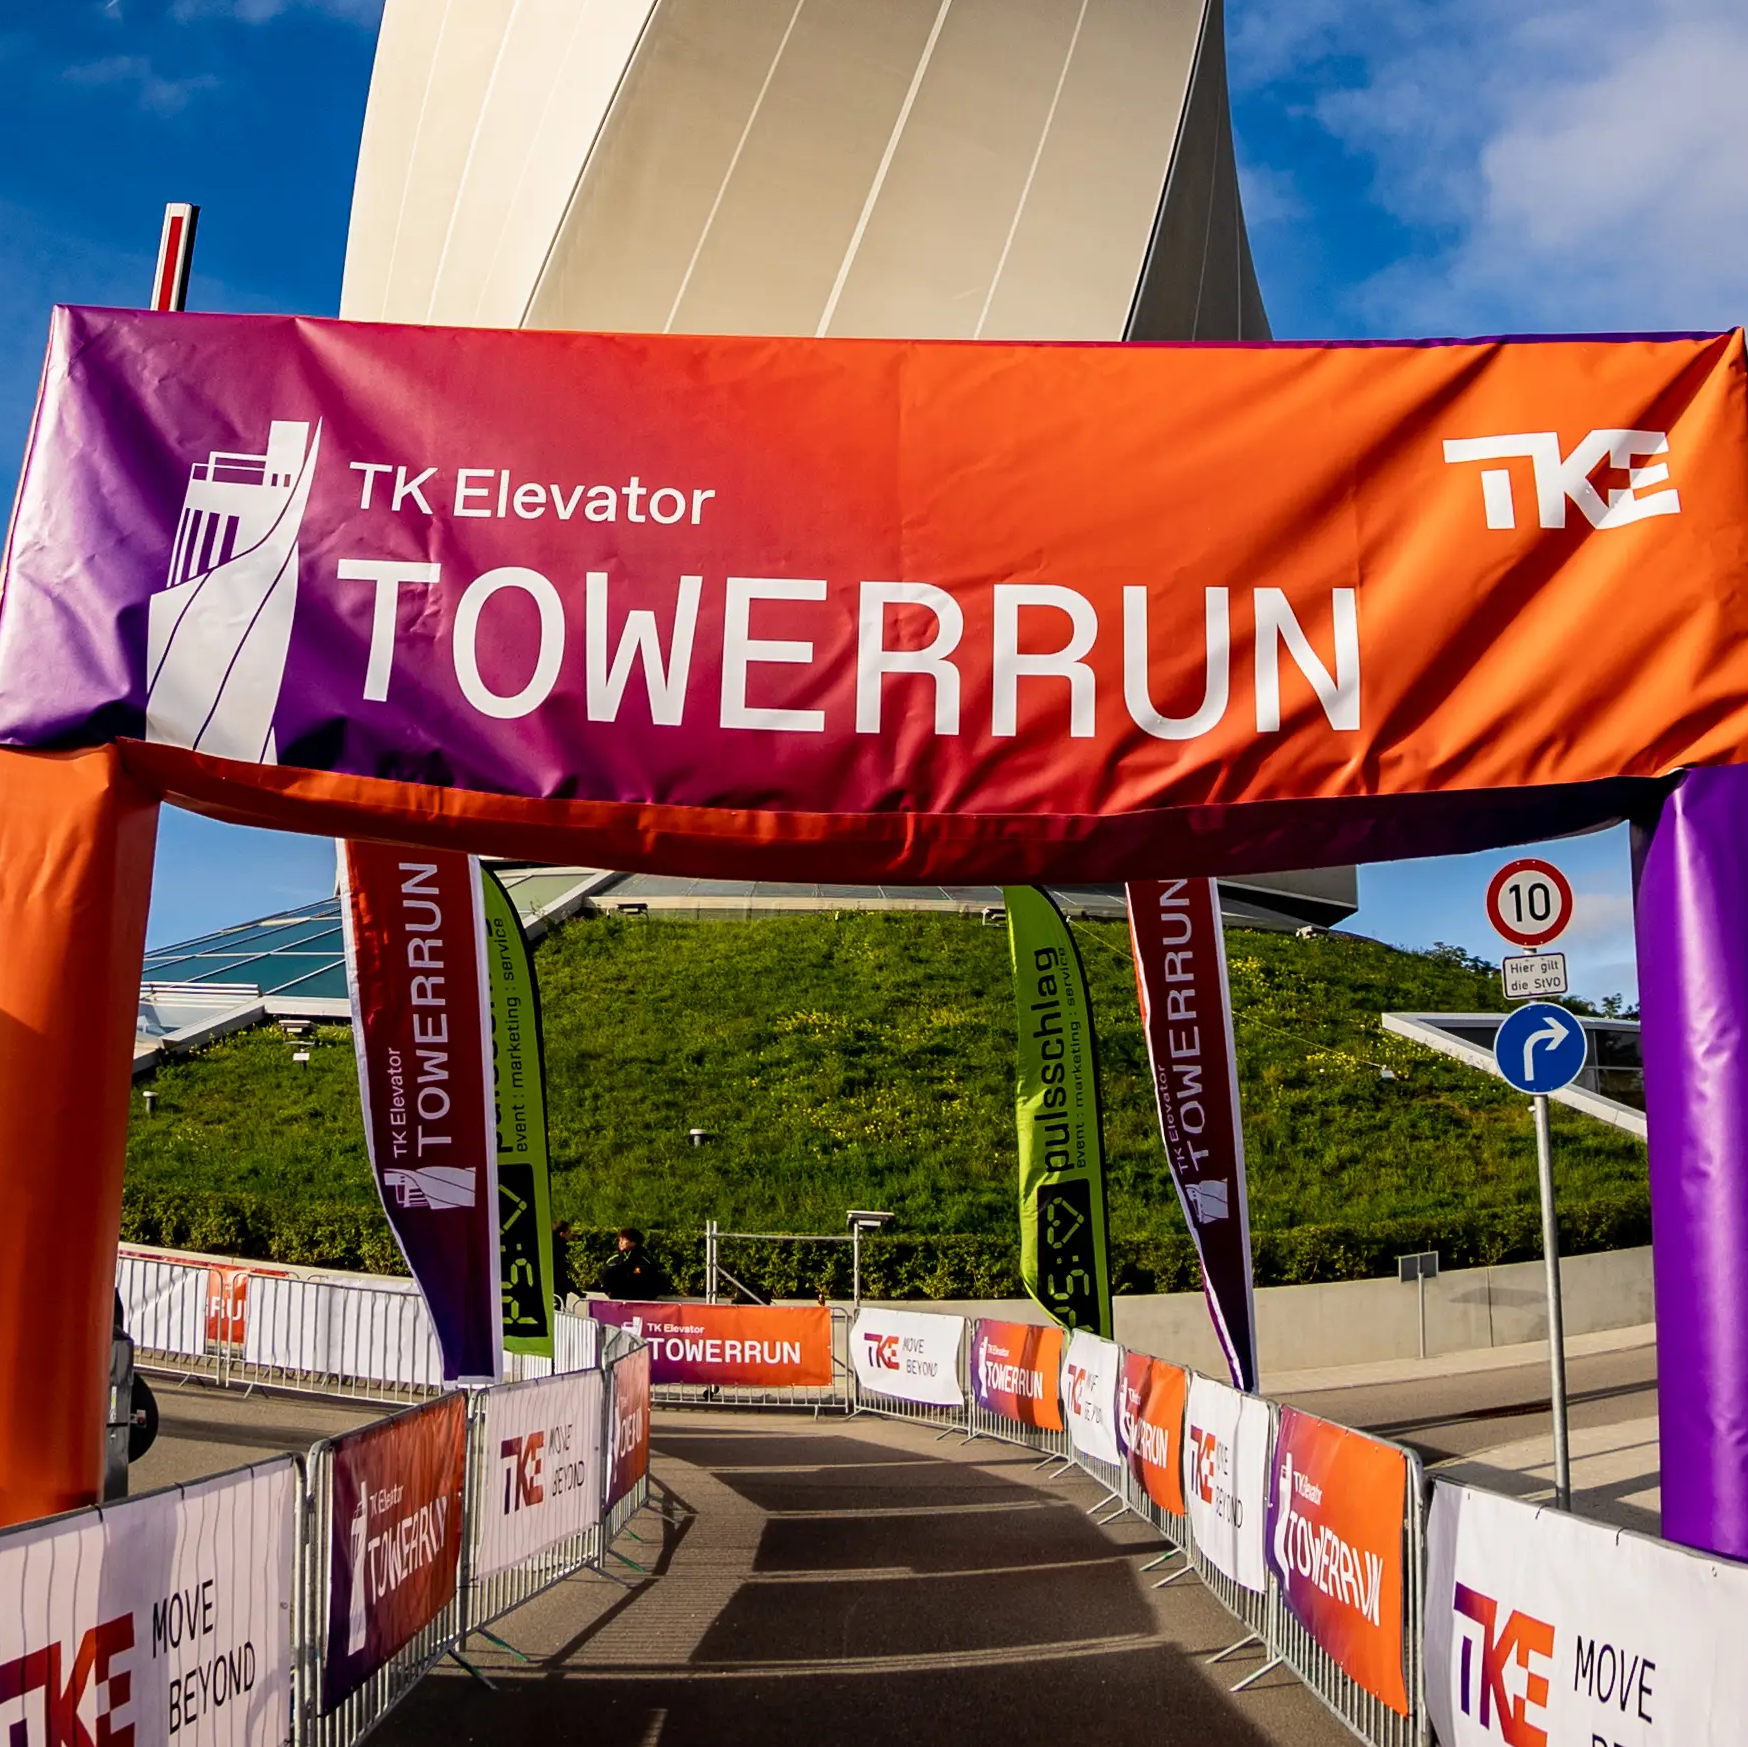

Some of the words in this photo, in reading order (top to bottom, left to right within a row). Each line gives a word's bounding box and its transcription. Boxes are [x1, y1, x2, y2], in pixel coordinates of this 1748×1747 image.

[349, 461, 440, 516] TK
[453, 468, 715, 527] Elevator
[1443, 428, 1680, 530] TKE
[338, 559, 1360, 740] TOWERRUN
[1509, 882, 1552, 922] 10
[494, 918, 515, 981] service
[1510, 963, 1534, 973] Hier
[1541, 960, 1559, 973] gilt
[1511, 980, 1528, 991] die
[1534, 977, 1561, 989] StVO
[399, 862, 452, 1157] TOWERRUN
[505, 997, 523, 1089] marketing
[1158, 878, 1209, 1171] TOWERRUN
[386, 1047, 406, 1127] Elevator
[1031, 946, 1074, 1173] pulsschlag
[1070, 1021, 1084, 1108] marketing
[513, 1103, 528, 1152] event
[1158, 1065, 1180, 1142] Elevator
[393, 1132, 407, 1158] TK
[1076, 1122, 1086, 1168] event
[1174, 1147, 1188, 1174] TK
[646, 1337, 800, 1364] TOWERRUN
[647, 1323, 662, 1332] TK
[663, 1323, 705, 1334] Elevator
[864, 1332, 900, 1370] TKE
[986, 1361, 1043, 1400] TOWERRUN
[501, 1430, 545, 1516] TKE
[1190, 1424, 1216, 1504] TKE
[1288, 1510, 1383, 1627] TOWERRUN
[153, 1578, 214, 1660] MOVE
[170, 1641, 256, 1736] BEYOND
[1454, 1581, 1556, 1747] TKE
[1574, 1634, 1656, 1724] MOVE
